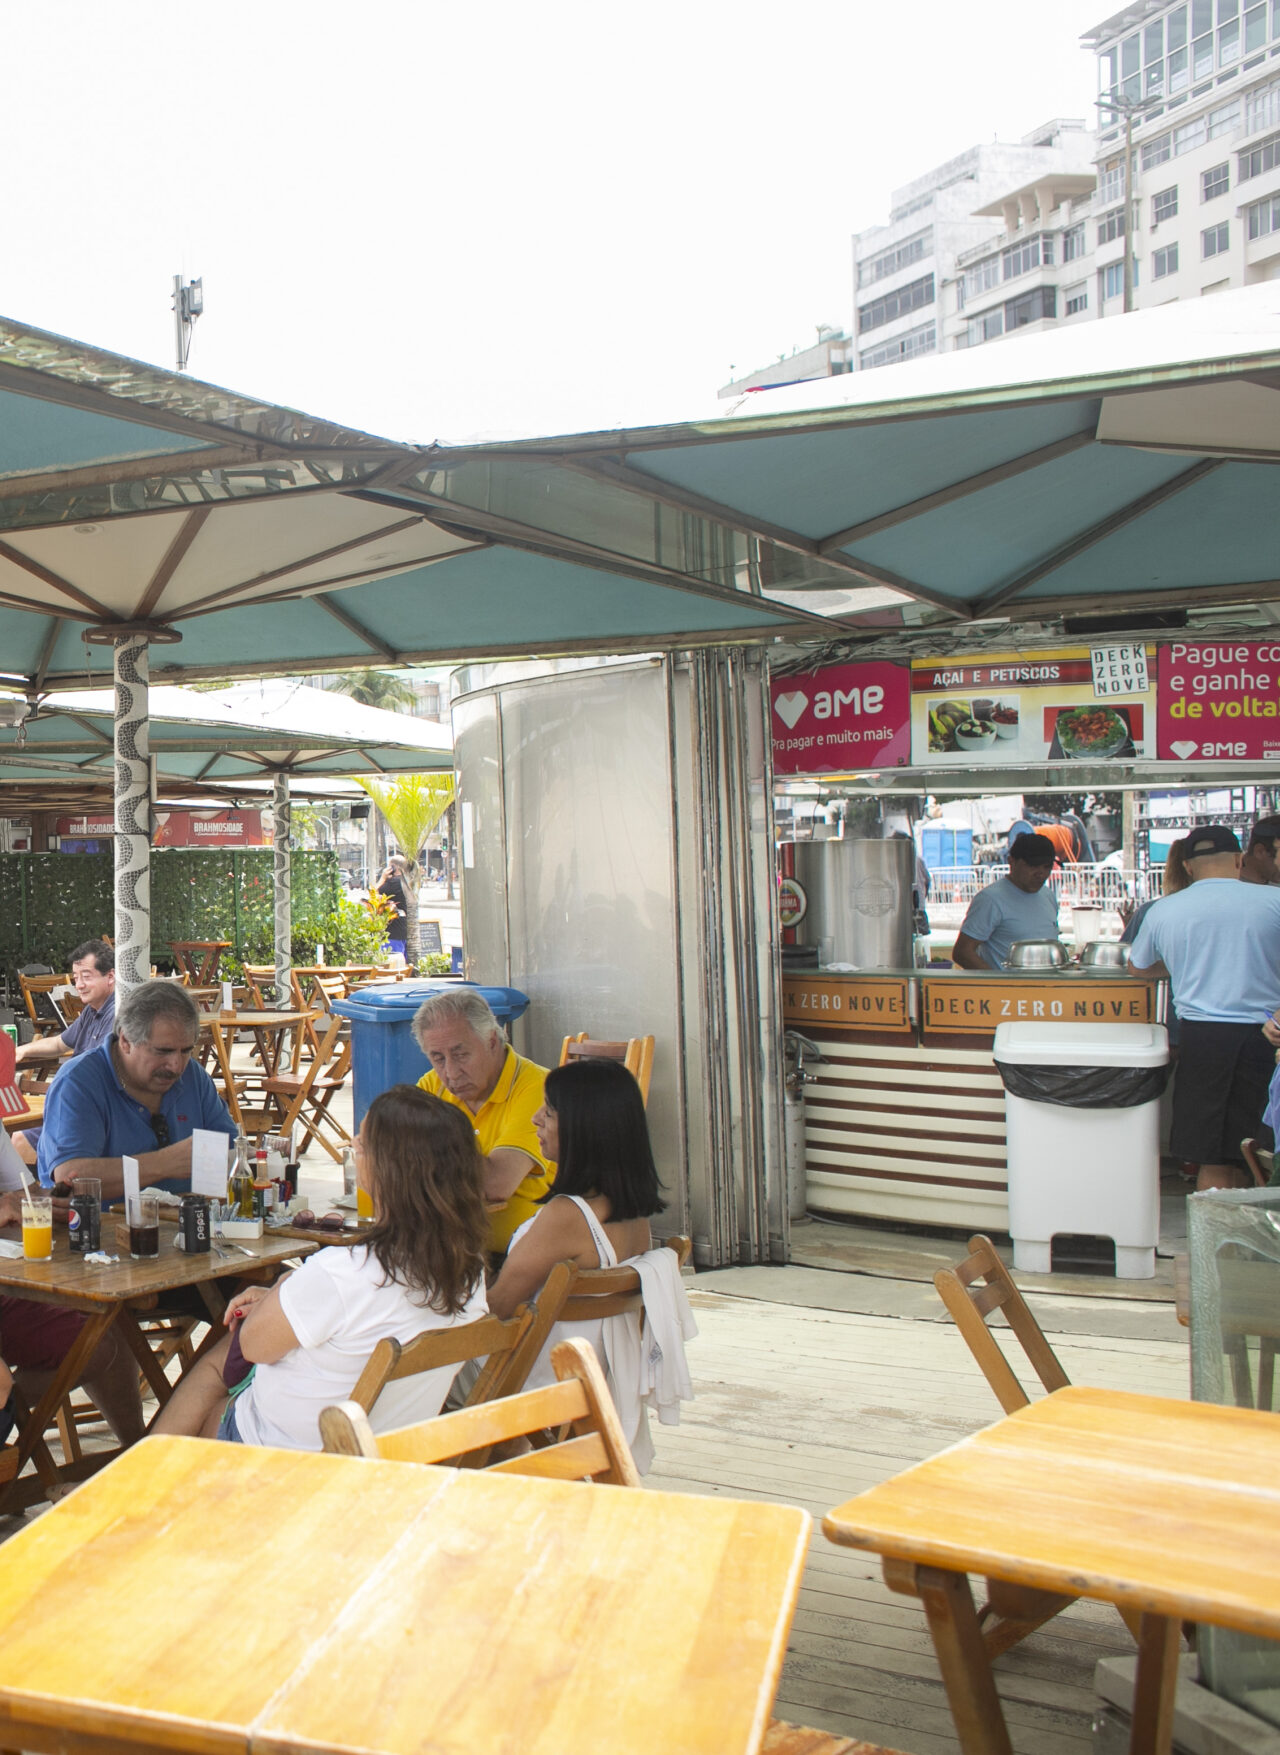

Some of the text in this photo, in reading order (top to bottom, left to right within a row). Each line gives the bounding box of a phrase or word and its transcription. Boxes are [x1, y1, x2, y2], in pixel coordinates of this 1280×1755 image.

[1094, 644, 1143, 663] DECK
[1171, 644, 1249, 668] Pague
[933, 666, 1060, 687] AÇAÍ E PETISCOS
[1096, 663, 1144, 679] ZERO
[1097, 678, 1146, 694] NOVE
[1170, 675, 1185, 691] e
[1192, 668, 1270, 695] ganhe
[1170, 696, 1203, 718] de
[787, 736, 815, 751] pagar
[816, 735, 824, 745] e
[826, 730, 860, 744] muito
[864, 726, 893, 741] mais
[69, 823, 115, 834] BRAHOSIDADE
[193, 822, 244, 833] BRAHMOSIDADE
[800, 993, 842, 1010] ZERO
[849, 996, 897, 1012] NOVE
[934, 998, 1140, 1017] DECK ZERO NOVE
[195, 1209, 206, 1240] pepsi
